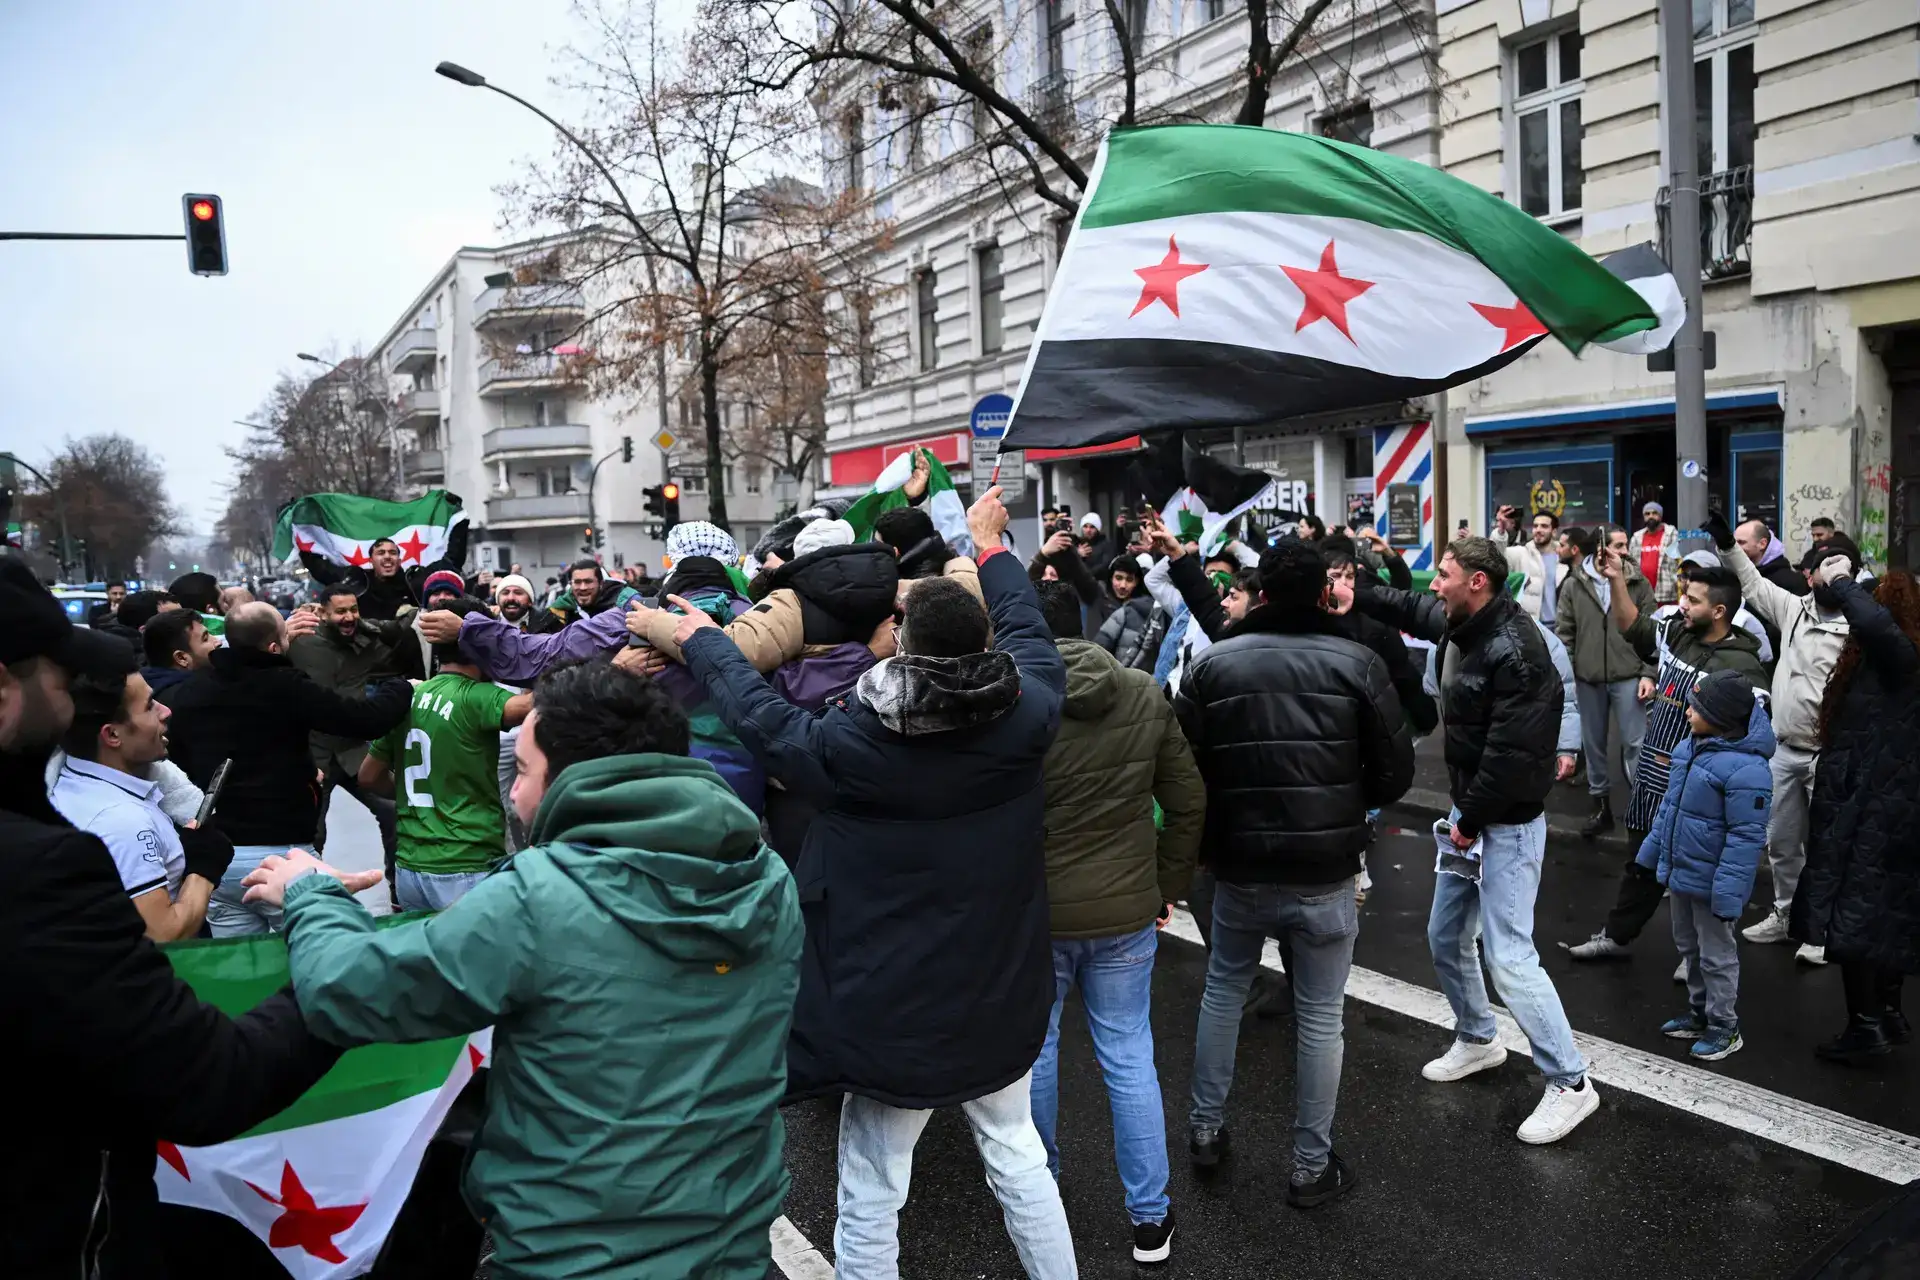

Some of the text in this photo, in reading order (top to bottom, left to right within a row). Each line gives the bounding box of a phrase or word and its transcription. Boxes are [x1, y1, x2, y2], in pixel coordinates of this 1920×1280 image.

[1537, 490, 1558, 508] 30
[404, 728, 435, 808] 2
[136, 829, 160, 863] 3
